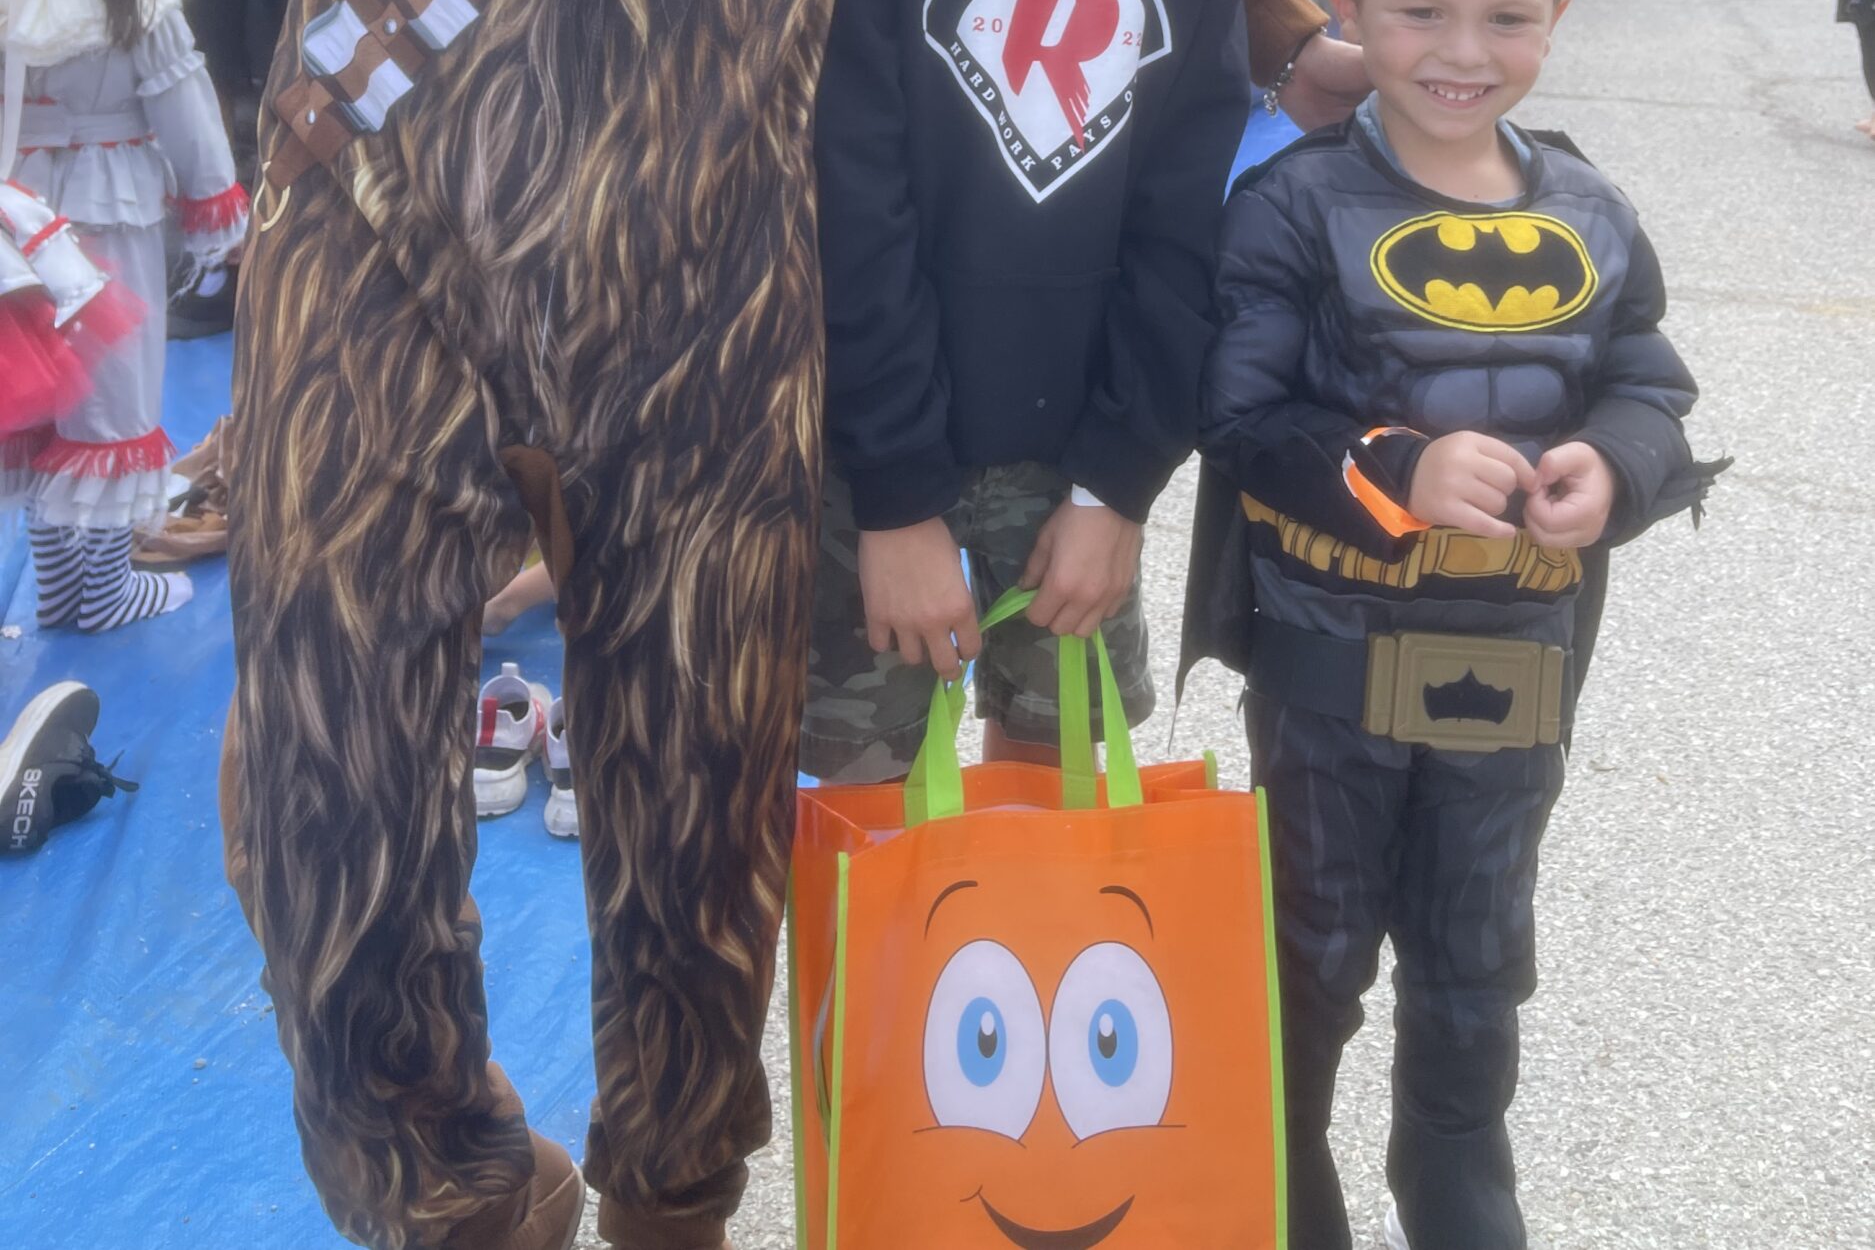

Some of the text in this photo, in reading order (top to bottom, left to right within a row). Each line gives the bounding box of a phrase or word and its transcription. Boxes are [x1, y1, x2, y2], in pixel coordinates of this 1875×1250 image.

[950, 42, 997, 102] HARD
[998, 110, 1037, 172] WORK
[1050, 115, 1112, 171] PAYS
